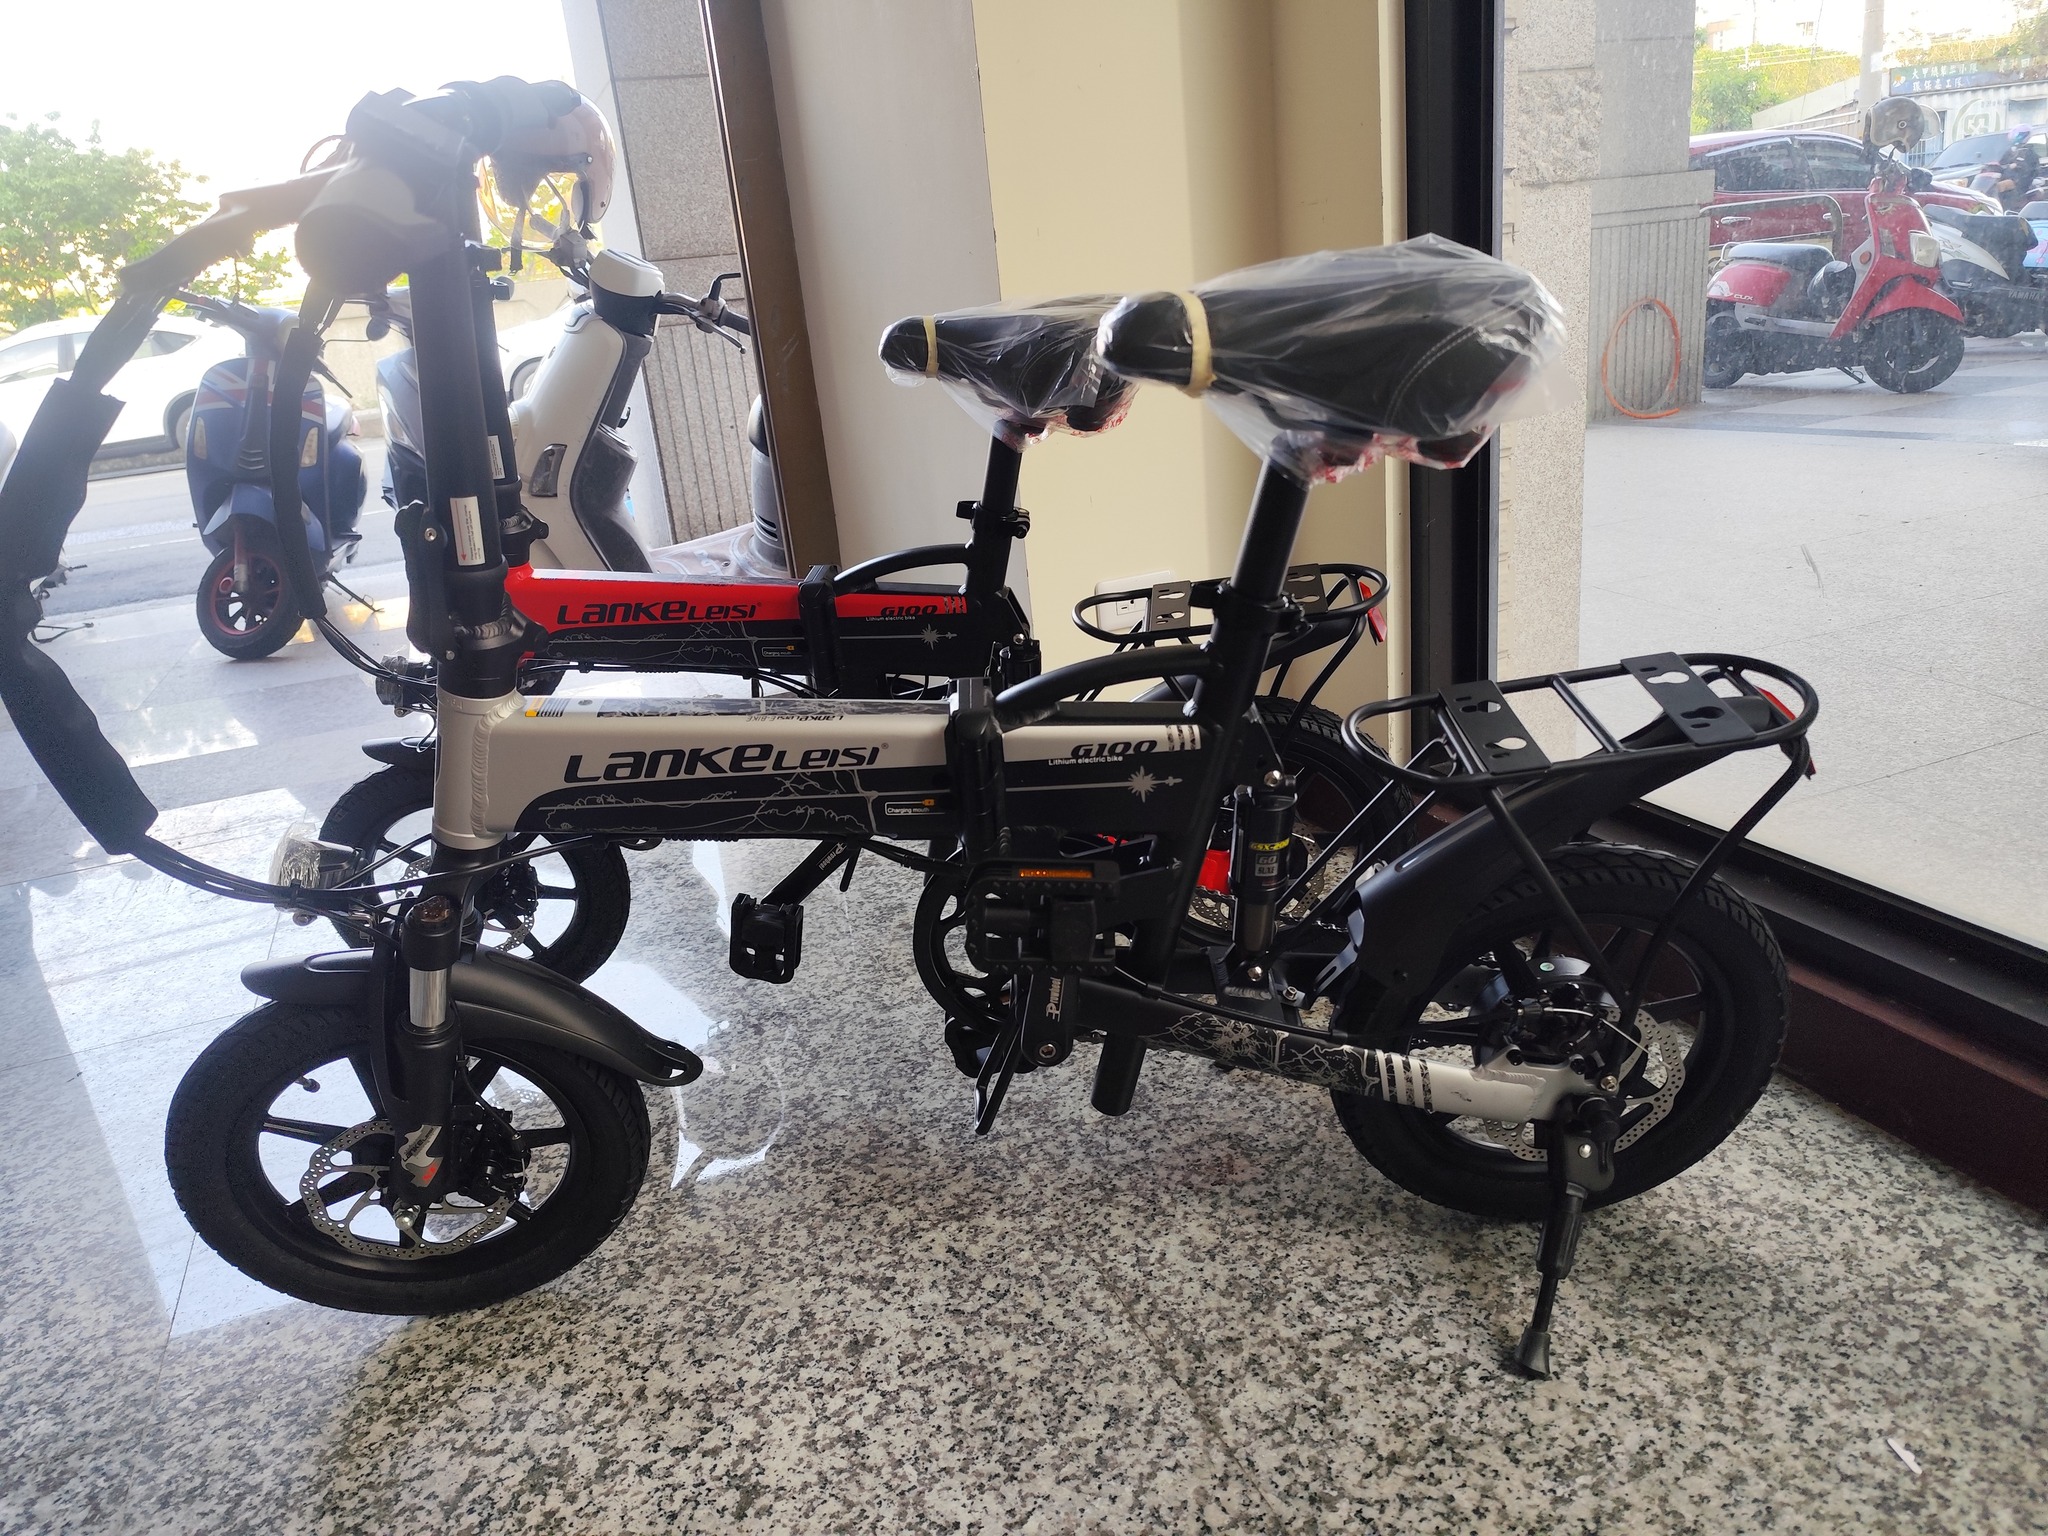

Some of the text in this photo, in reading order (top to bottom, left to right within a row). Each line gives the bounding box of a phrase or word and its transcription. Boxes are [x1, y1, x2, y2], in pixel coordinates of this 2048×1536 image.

[2008, 290, 2040, 300] YAMAHA
[880, 605, 938, 617] G100
[1071, 740, 1157, 758] G100
[1048, 755, 1123, 766] Lithium electric bike
